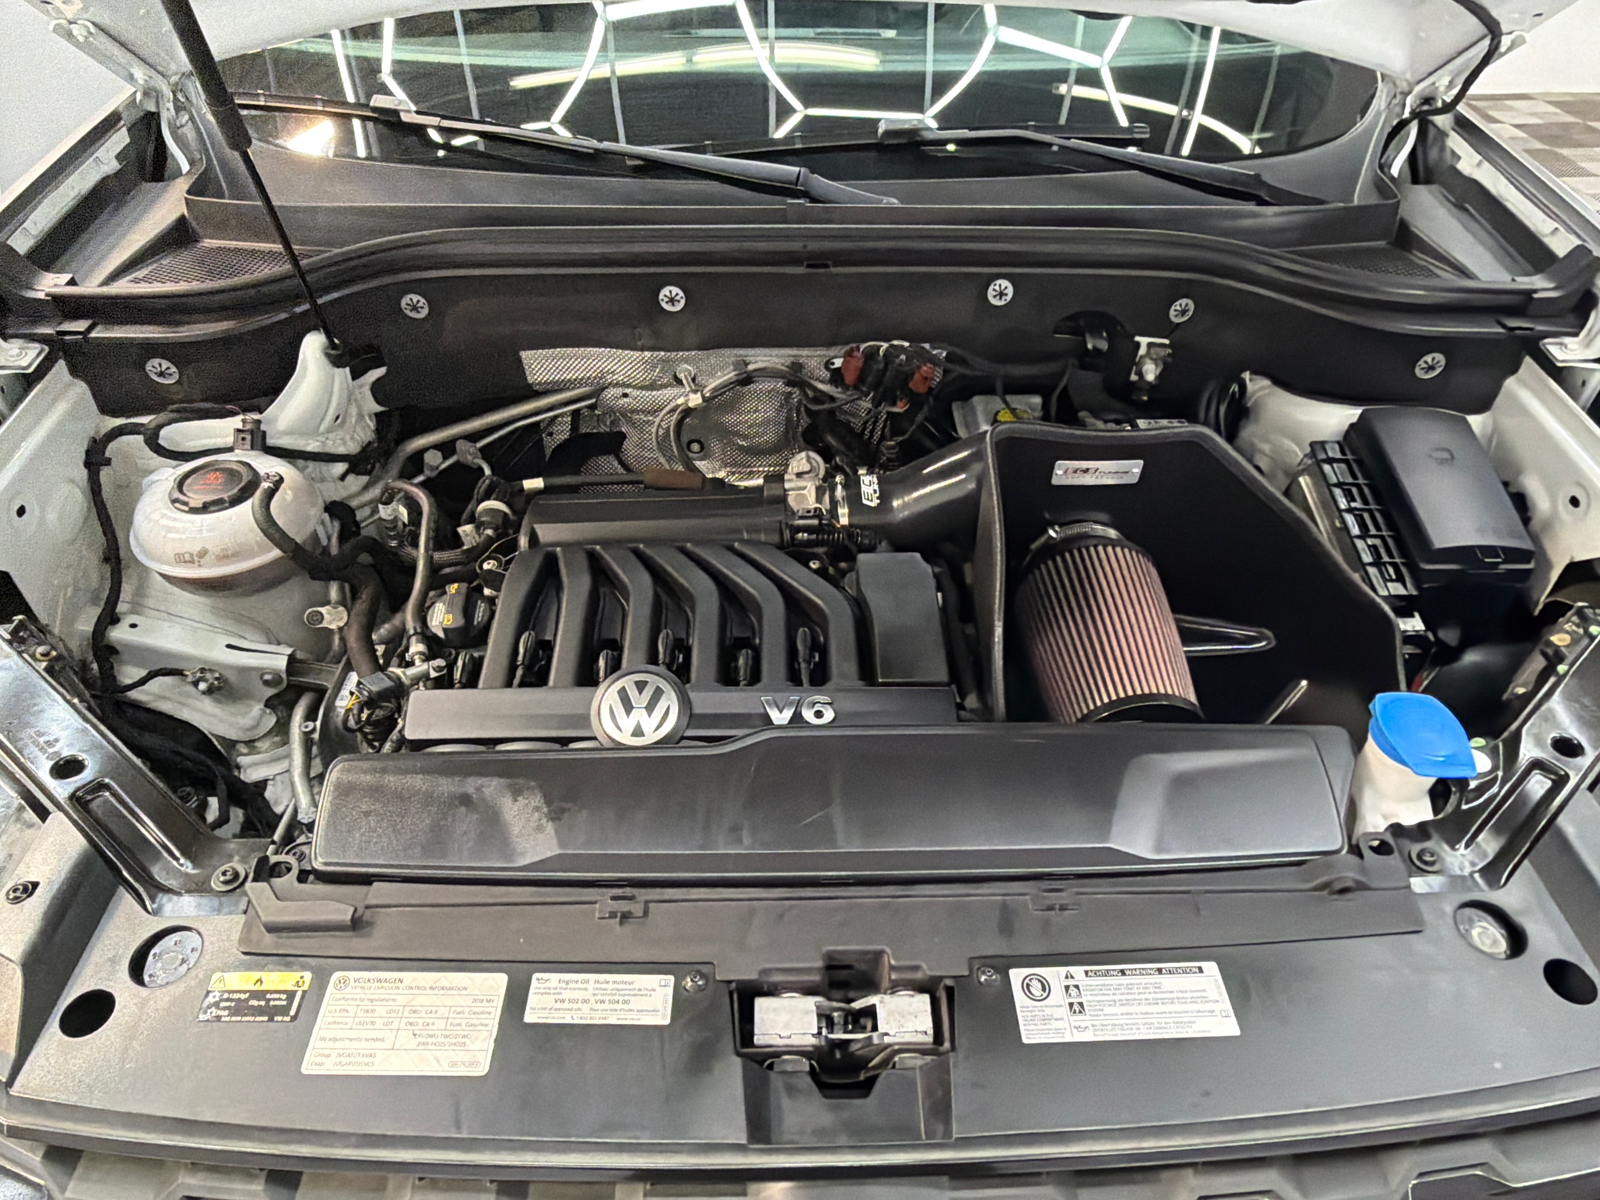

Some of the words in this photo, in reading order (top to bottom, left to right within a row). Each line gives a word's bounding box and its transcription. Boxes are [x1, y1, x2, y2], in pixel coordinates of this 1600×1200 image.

[761, 696, 836, 725] V6
[1088, 969, 1122, 977] ACHTUNG
[1124, 968, 1159, 976] WARNING
[1162, 966, 1200, 974] ATTENTION
[558, 978, 580, 986] Engine
[594, 978, 611, 986] Huile
